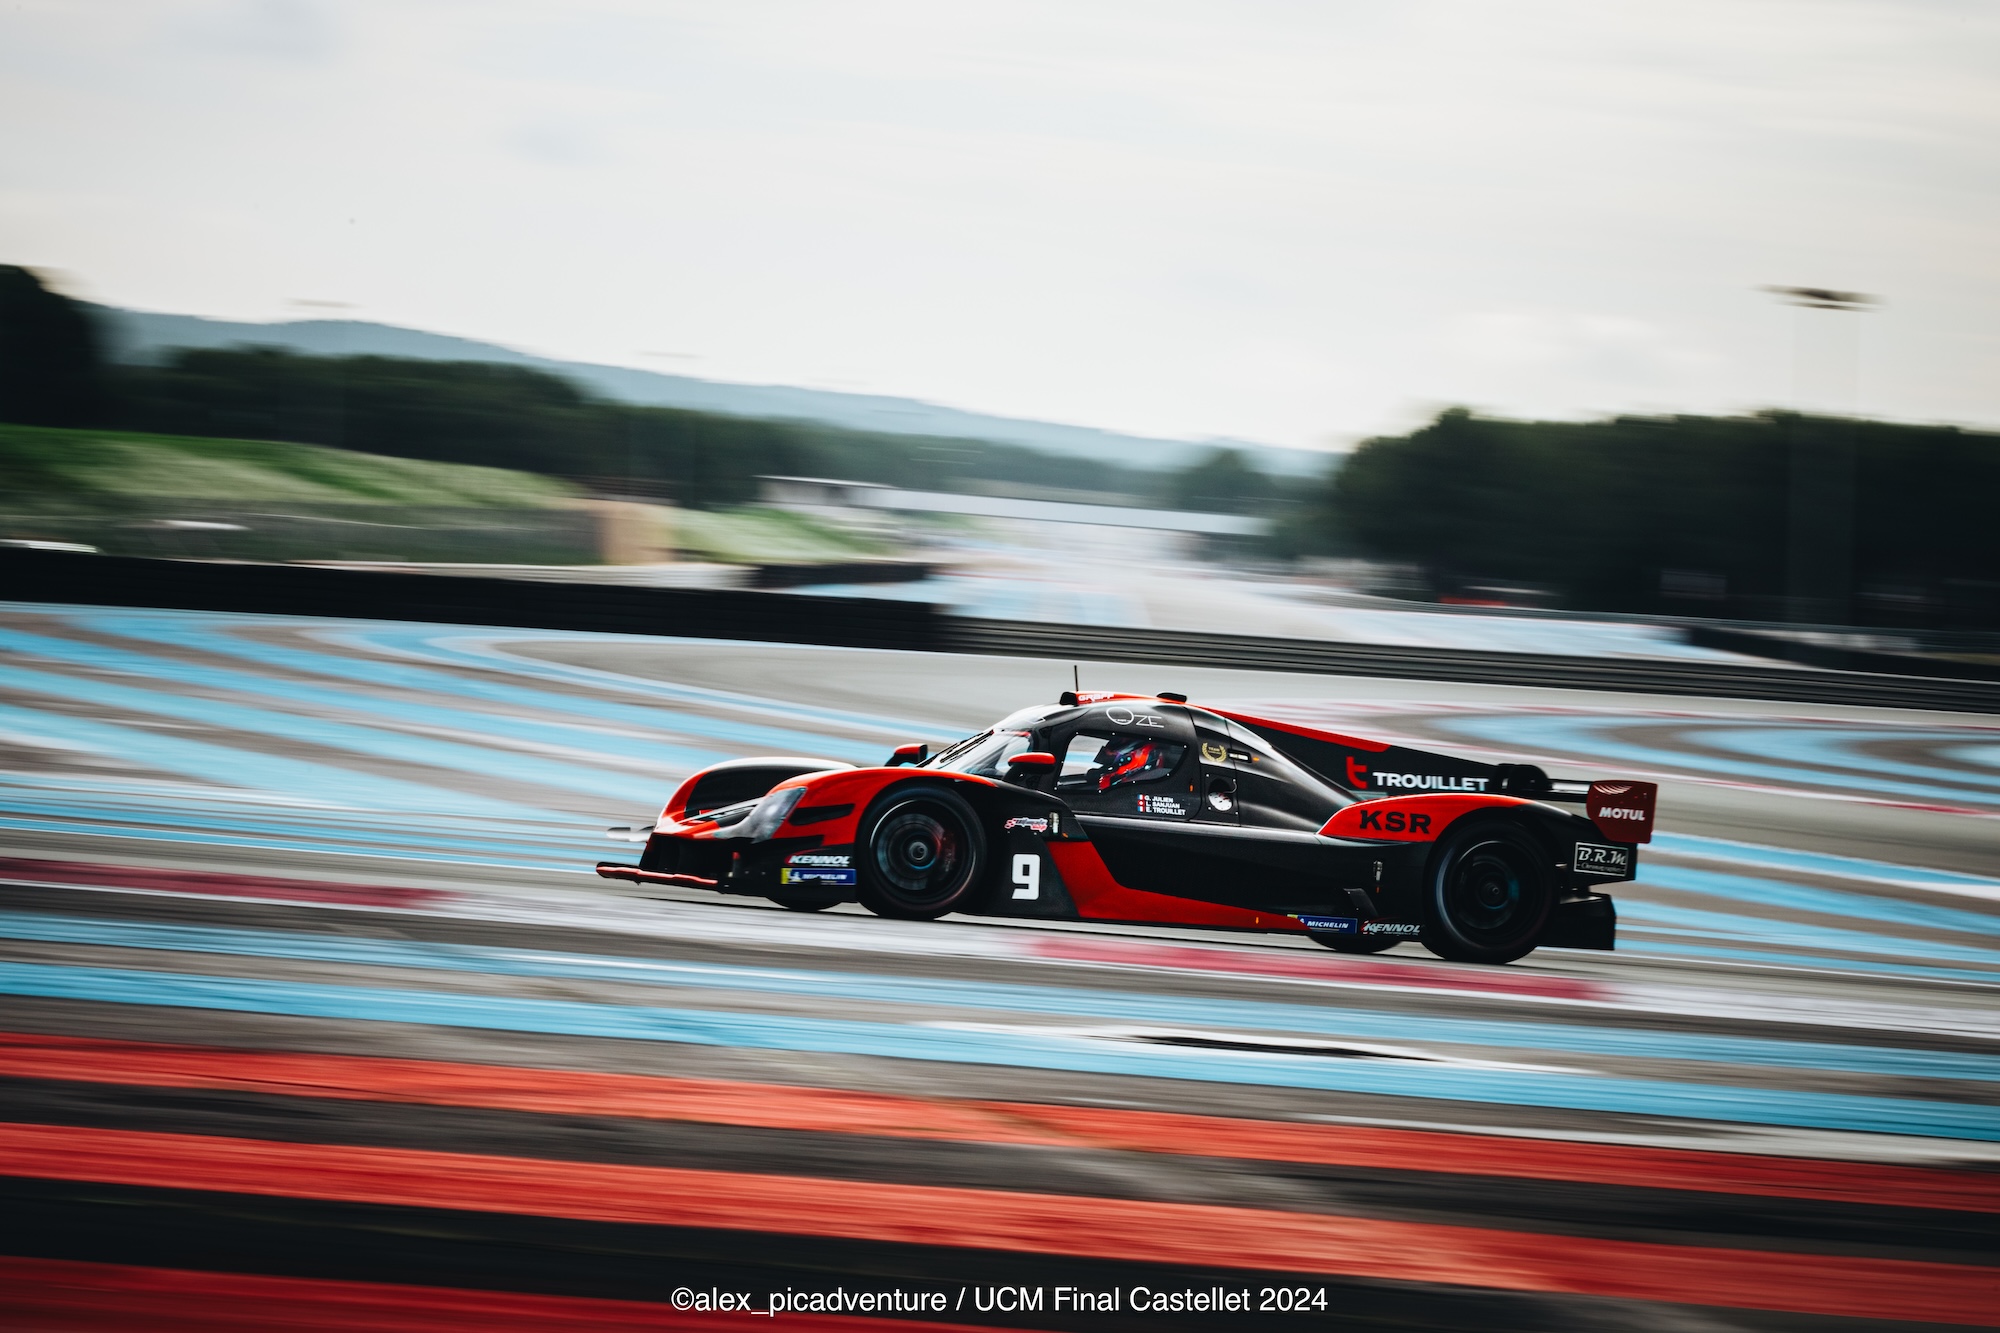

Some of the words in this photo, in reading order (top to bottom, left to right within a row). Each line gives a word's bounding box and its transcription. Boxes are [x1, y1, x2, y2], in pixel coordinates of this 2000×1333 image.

[1372, 772, 1490, 791] TROUILLET
[1152, 801, 1180, 809] SANJUAN
[1152, 807, 1186, 815] TROUILLET
[1599, 807, 1646, 821] MOTUL
[1360, 810, 1431, 834] KSR
[788, 855, 850, 864] KENNOL
[1012, 854, 1040, 900] 9
[1307, 920, 1349, 929] MICHELIN
[1363, 923, 1421, 933] KENNOL
